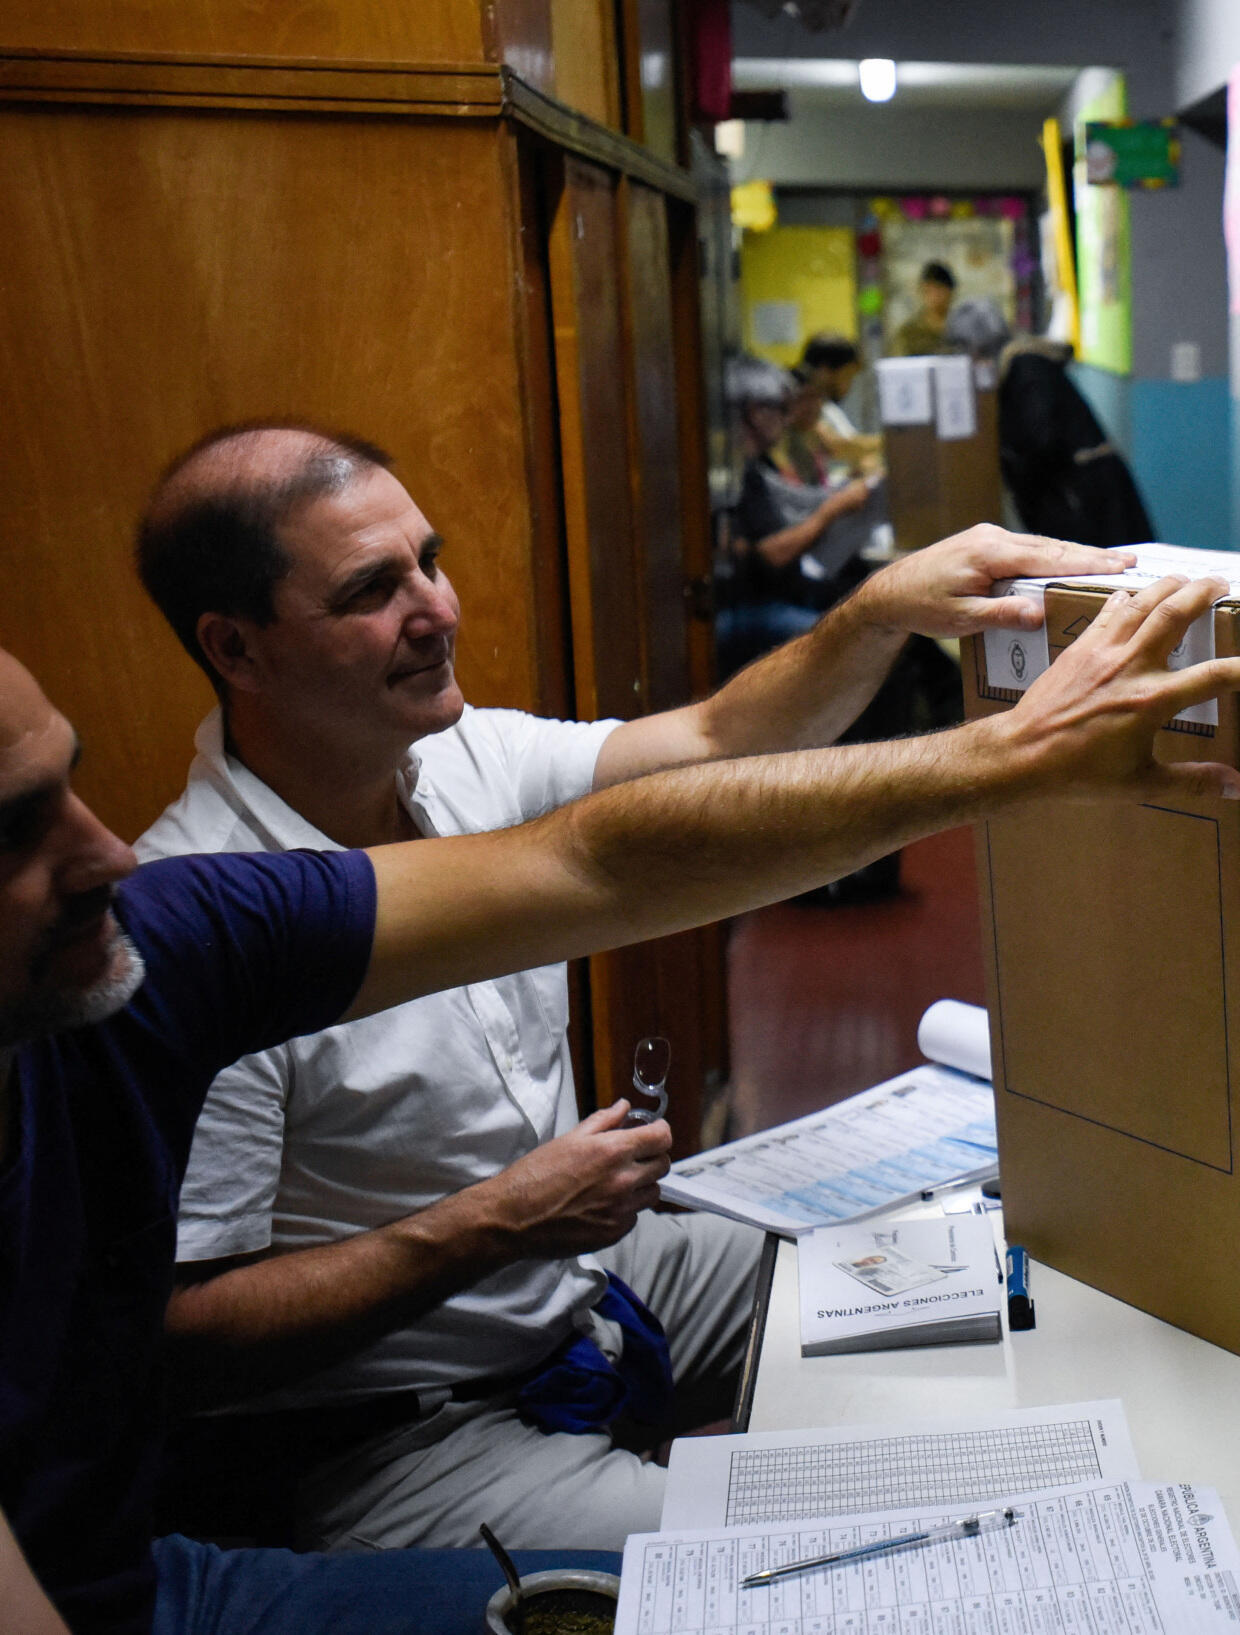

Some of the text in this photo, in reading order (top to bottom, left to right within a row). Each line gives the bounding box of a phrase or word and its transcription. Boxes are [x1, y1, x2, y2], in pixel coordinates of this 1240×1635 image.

[904, 1288, 984, 1307] ELECCIONES
[817, 1301, 899, 1318] ARGENTINAS
[1194, 1527, 1216, 1569] ARGENTINA
